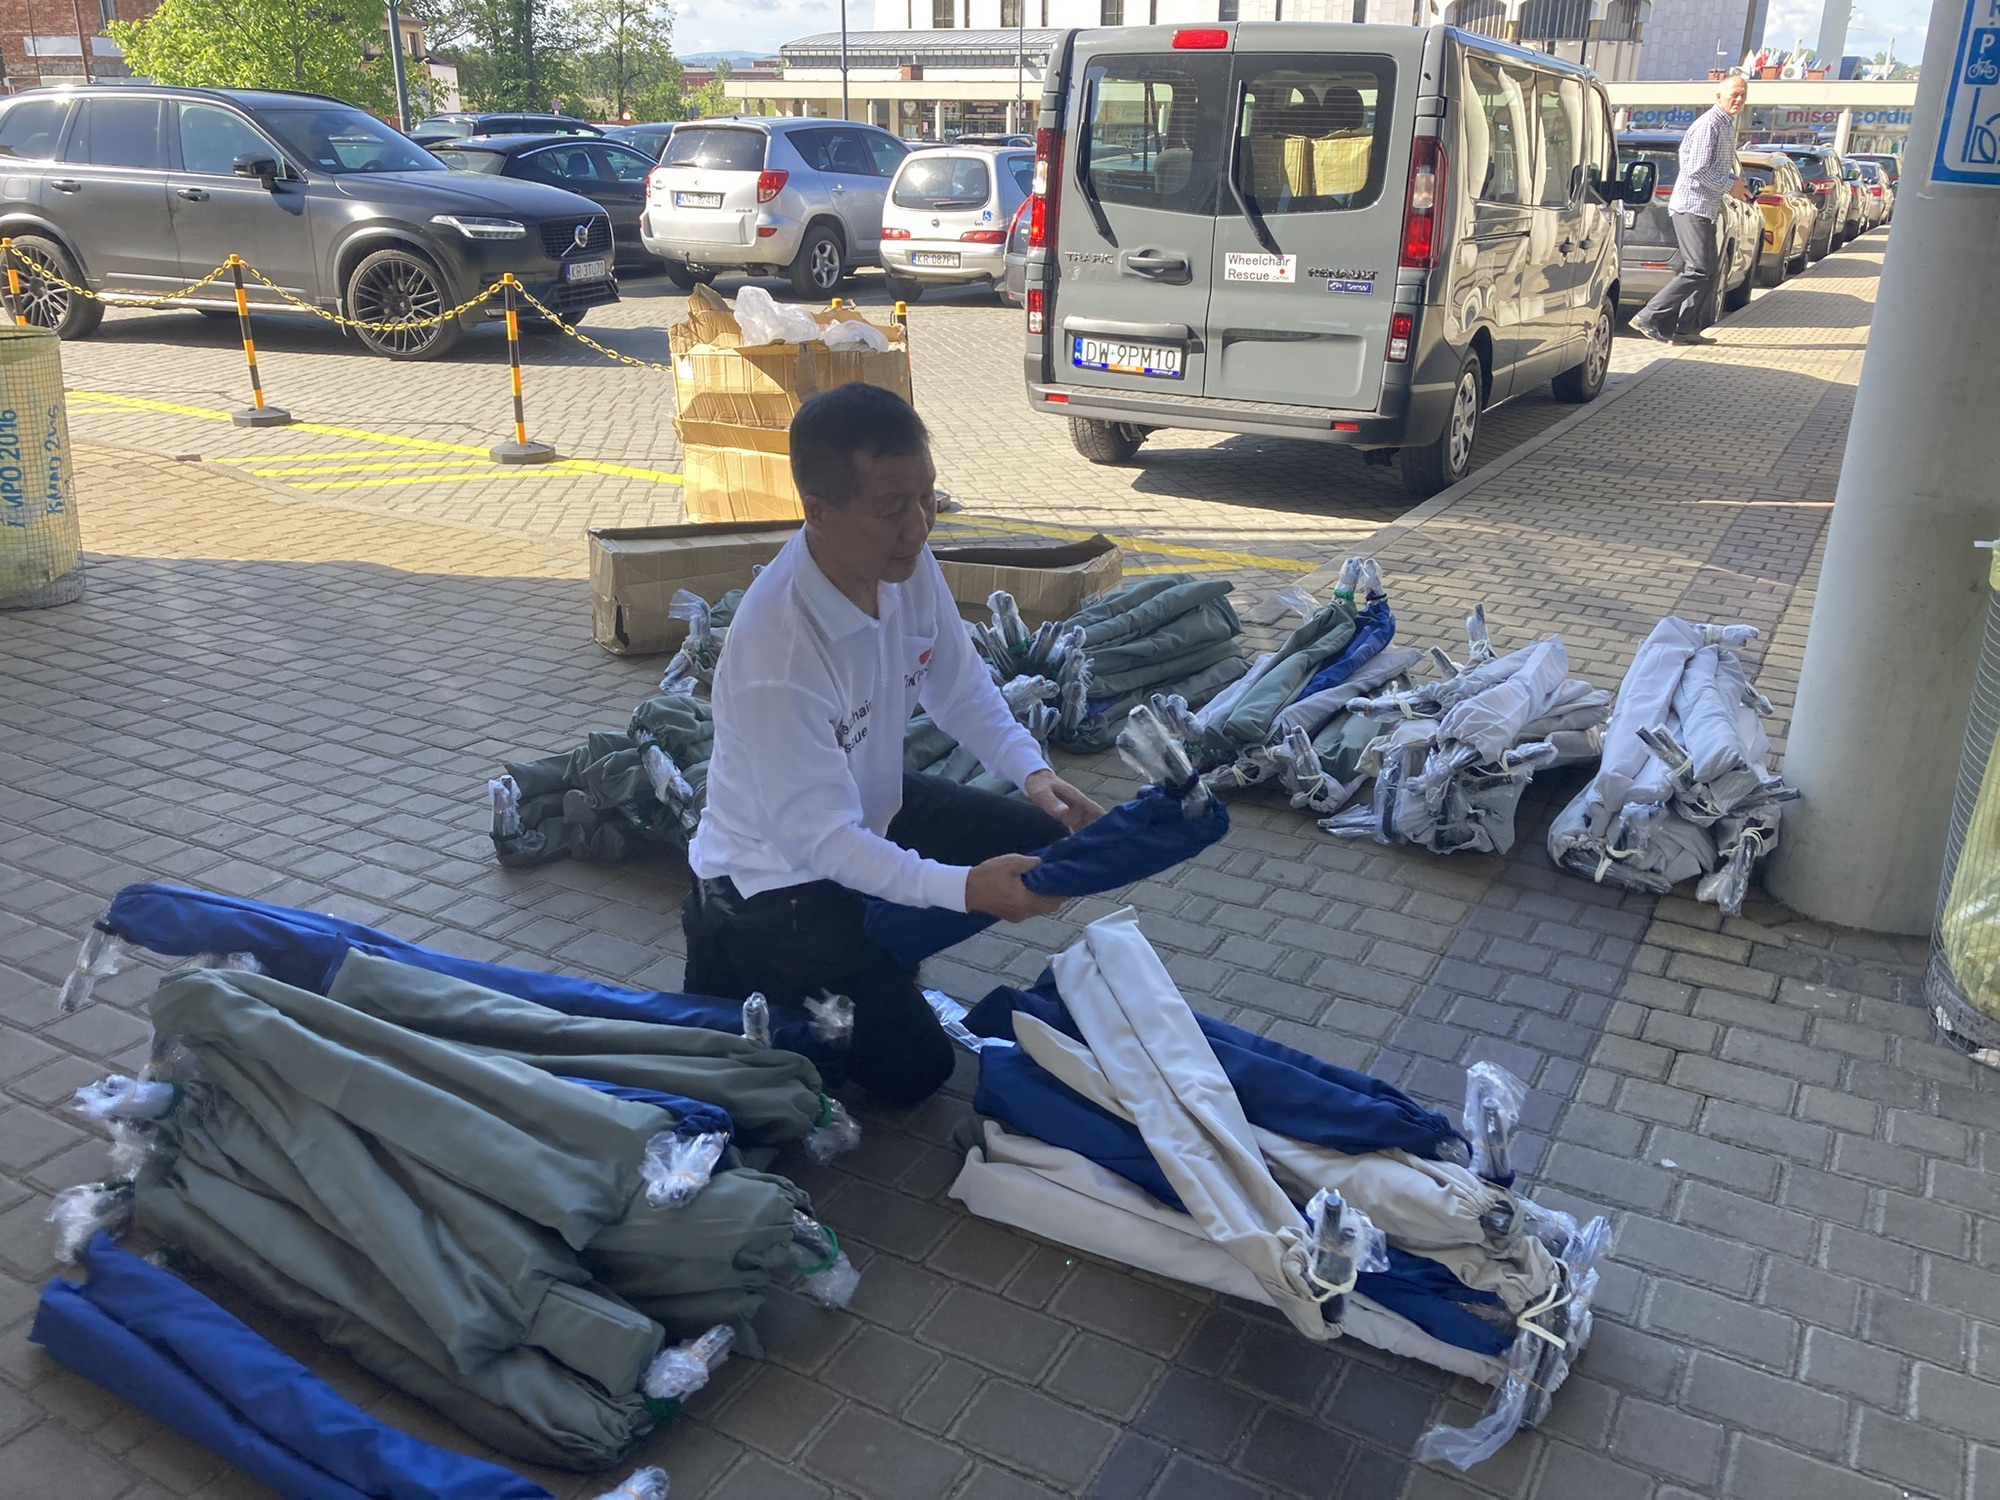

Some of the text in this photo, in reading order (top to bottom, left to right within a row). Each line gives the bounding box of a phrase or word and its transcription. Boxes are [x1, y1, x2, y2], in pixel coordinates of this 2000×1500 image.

[1979, 33, 1996, 54] P
[1625, 106, 1695, 122] icordia
[1785, 106, 1913, 124] misercordia
[1228, 254, 1291, 267] Wheelchair
[571, 264, 582, 279] KR
[1228, 268, 1270, 281] Rescue
[1307, 267, 1379, 281] RENAULT
[1086, 341, 1177, 370] DW 9PM10
